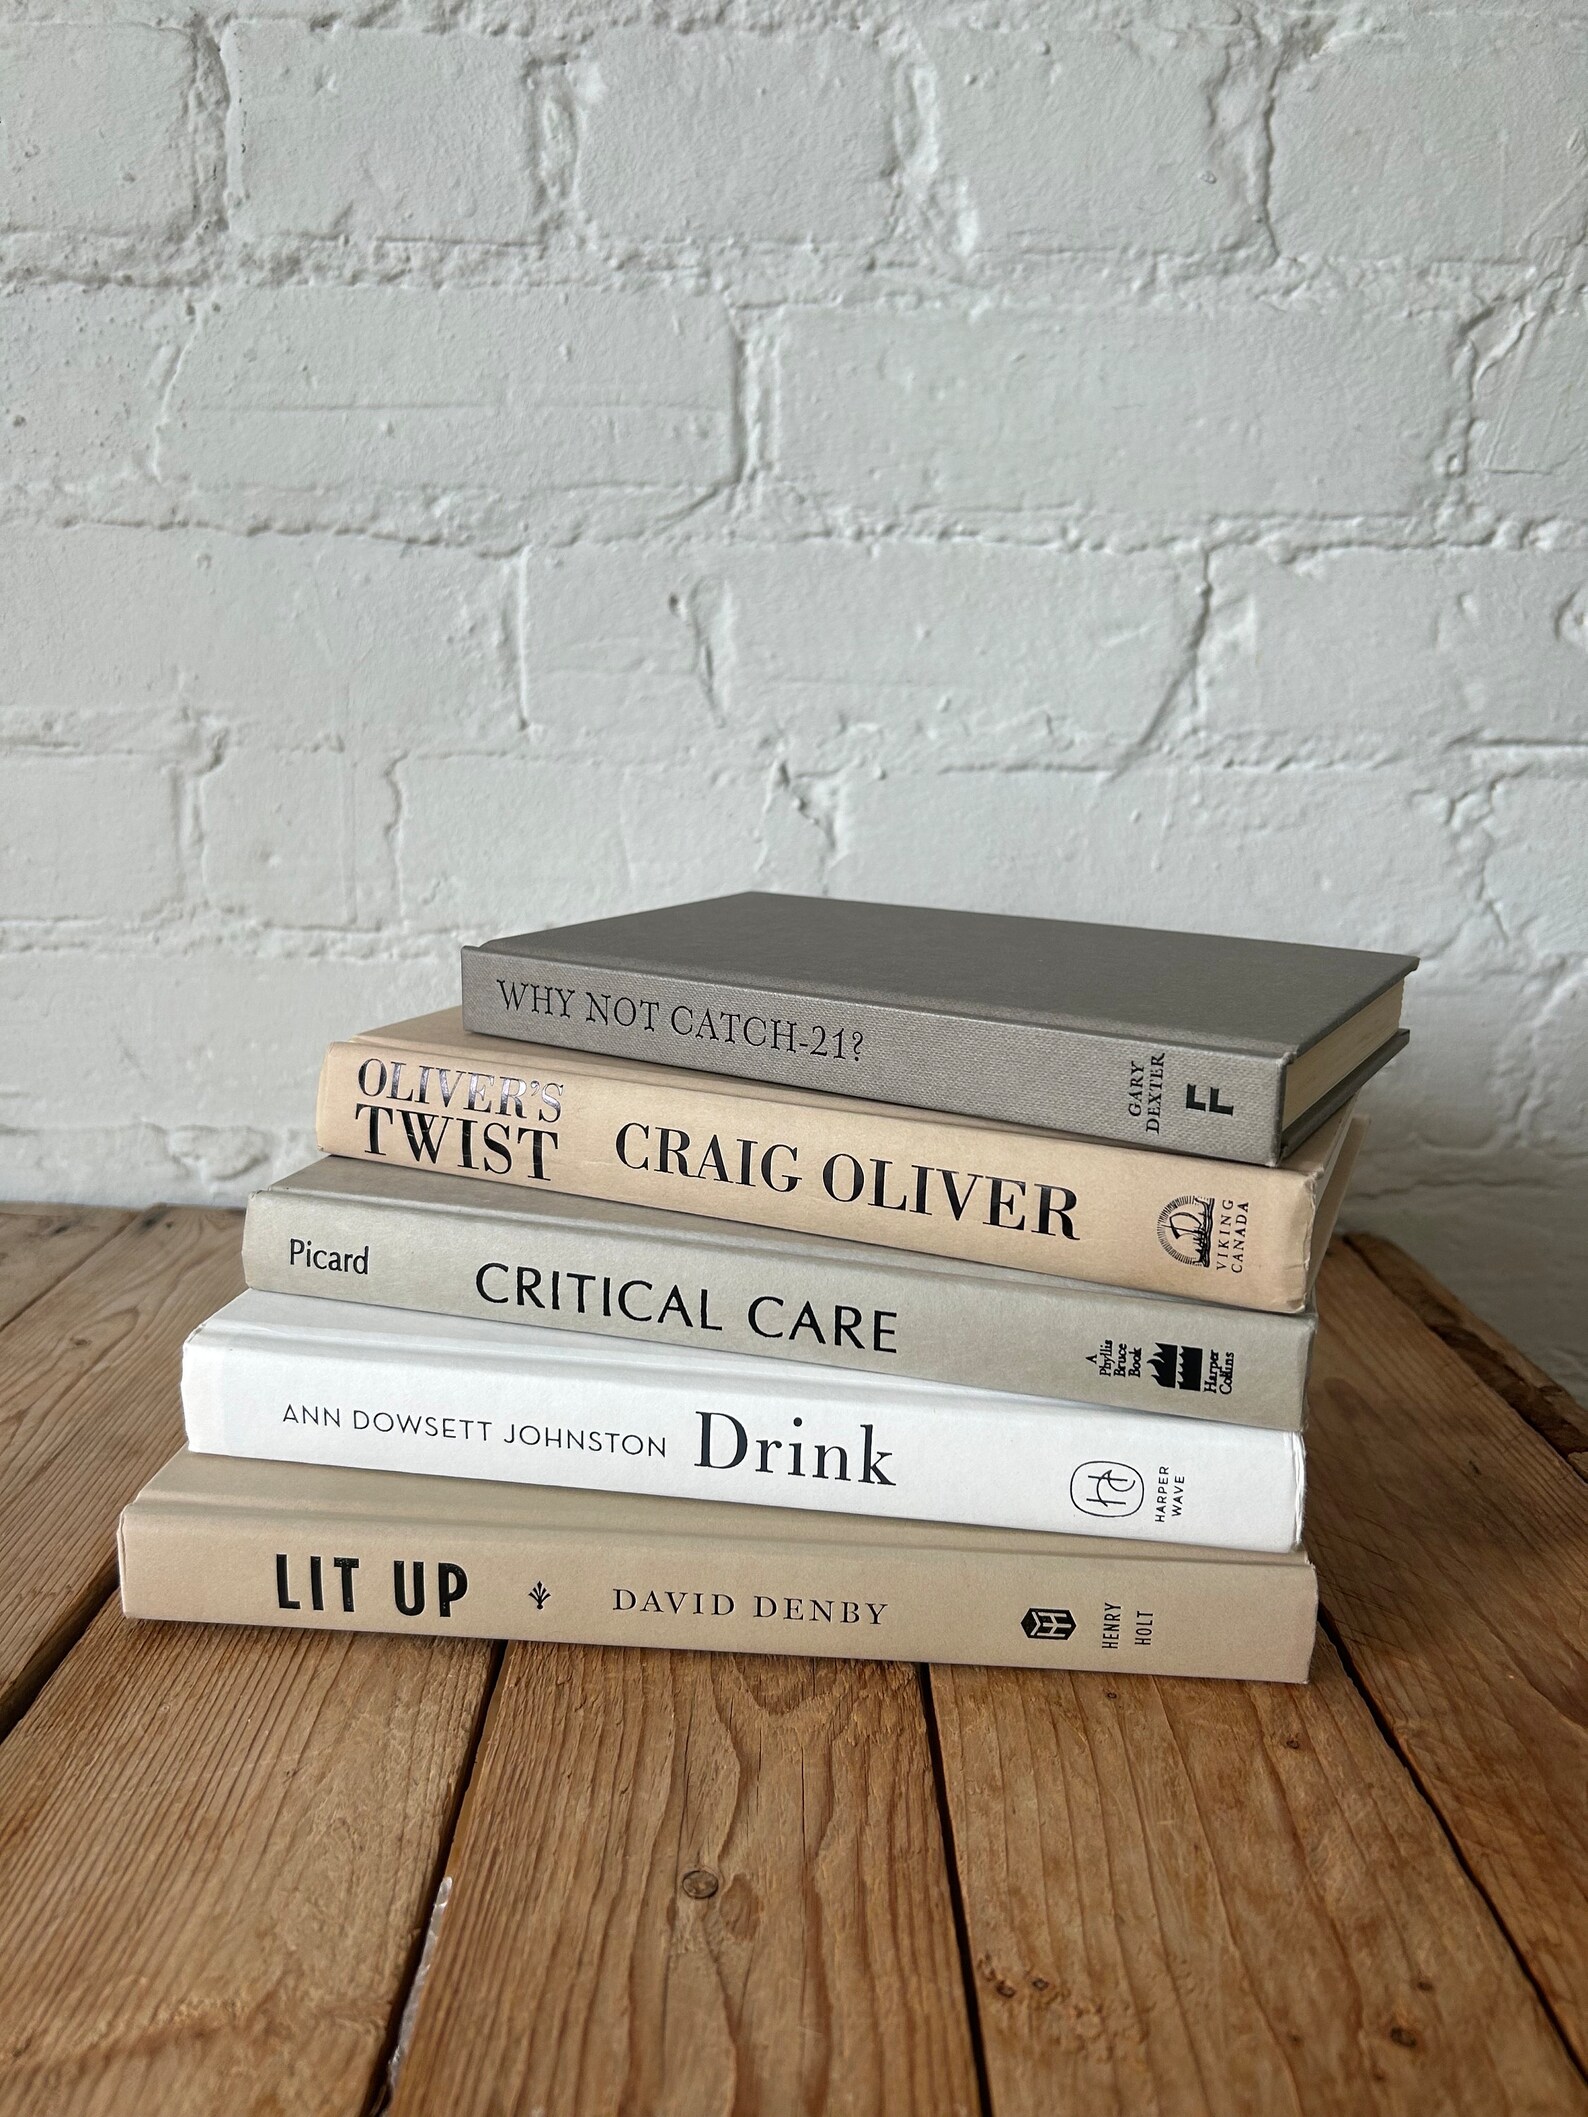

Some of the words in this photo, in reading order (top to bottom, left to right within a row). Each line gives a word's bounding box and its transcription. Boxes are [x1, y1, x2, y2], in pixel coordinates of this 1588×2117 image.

[496, 978, 576, 1019] WHY
[585, 991, 661, 1033] NOT
[669, 1003, 865, 1063] CATCH-21?
[1128, 1060, 1145, 1117] GARY
[1146, 1052, 1166, 1136] DEXTER
[354, 1102, 559, 1183] TWIST
[615, 1122, 803, 1193] CRAIG
[822, 1153, 1081, 1241] OLIVER
[289, 1239, 369, 1275] Picard
[1216, 1199, 1235, 1271] VIKING
[1231, 1202, 1250, 1274] CANADA
[475, 1262, 723, 1332] CRITICAL
[747, 1296, 899, 1354] CARE
[1085, 1353, 1098, 1364] A
[1099, 1339, 1115, 1377] Phyllis
[1113, 1343, 1127, 1378] Bruce
[1128, 1347, 1142, 1378] Book
[1203, 1349, 1221, 1394] Harper
[1219, 1351, 1234, 1395] Collins
[282, 1403, 342, 1428] ANN
[353, 1410, 493, 1443] DOWSETT
[502, 1423, 668, 1459] JOHNSTON
[694, 1411, 897, 1487] Drink
[1154, 1466, 1169, 1523] HARPER
[1171, 1475, 1185, 1517] WAVE
[275, 1553, 360, 1613] LIT
[393, 1560, 469, 1618] UP
[612, 1588, 736, 1618] DAVID
[752, 1597, 889, 1626] DENBY
[1101, 1602, 1122, 1650] HENRY
[1134, 1610, 1154, 1646] HOLT
